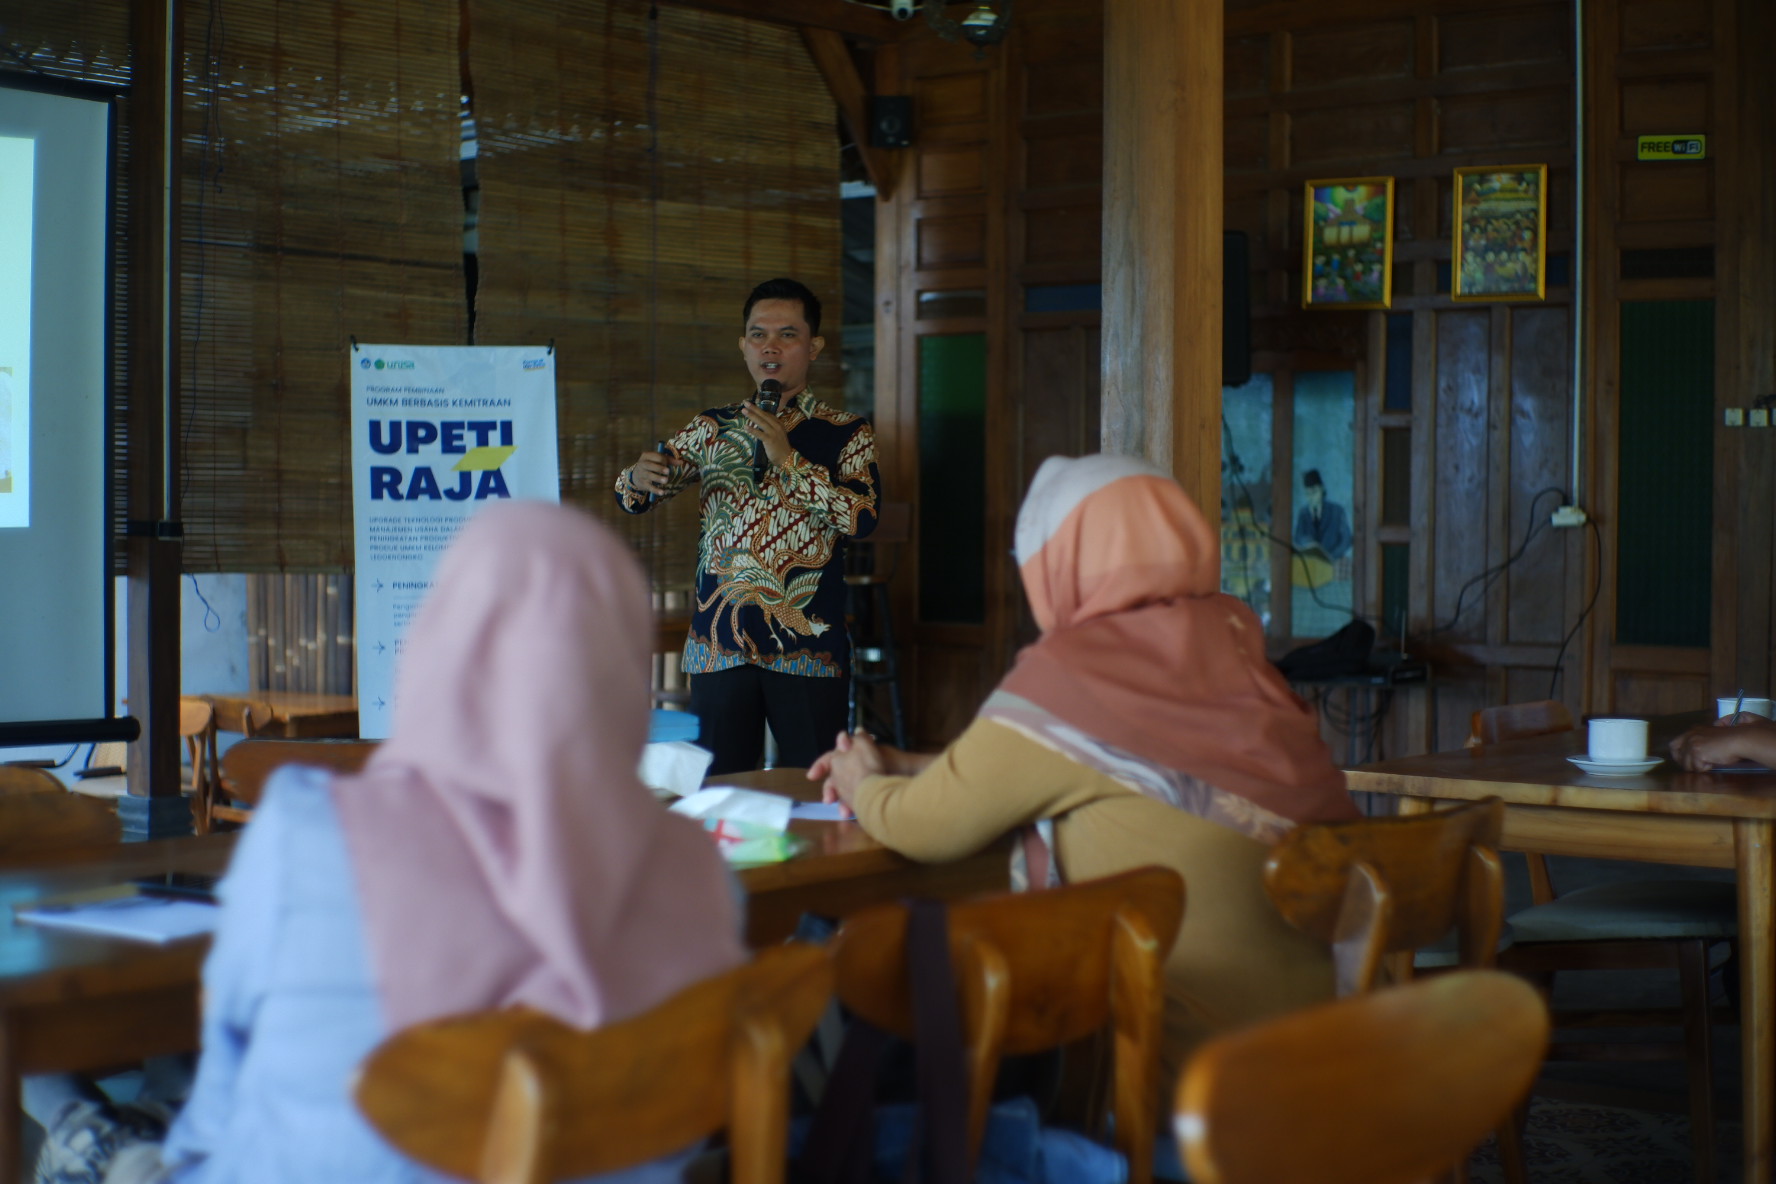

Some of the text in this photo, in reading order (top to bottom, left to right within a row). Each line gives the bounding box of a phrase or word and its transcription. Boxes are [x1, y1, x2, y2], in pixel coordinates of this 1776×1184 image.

[1641, 141, 1671, 153] FREE
[366, 397, 512, 408] UMKM BERBASIS KEMITRAAN
[368, 419, 514, 455] UPETI
[370, 466, 511, 501] RAJA
